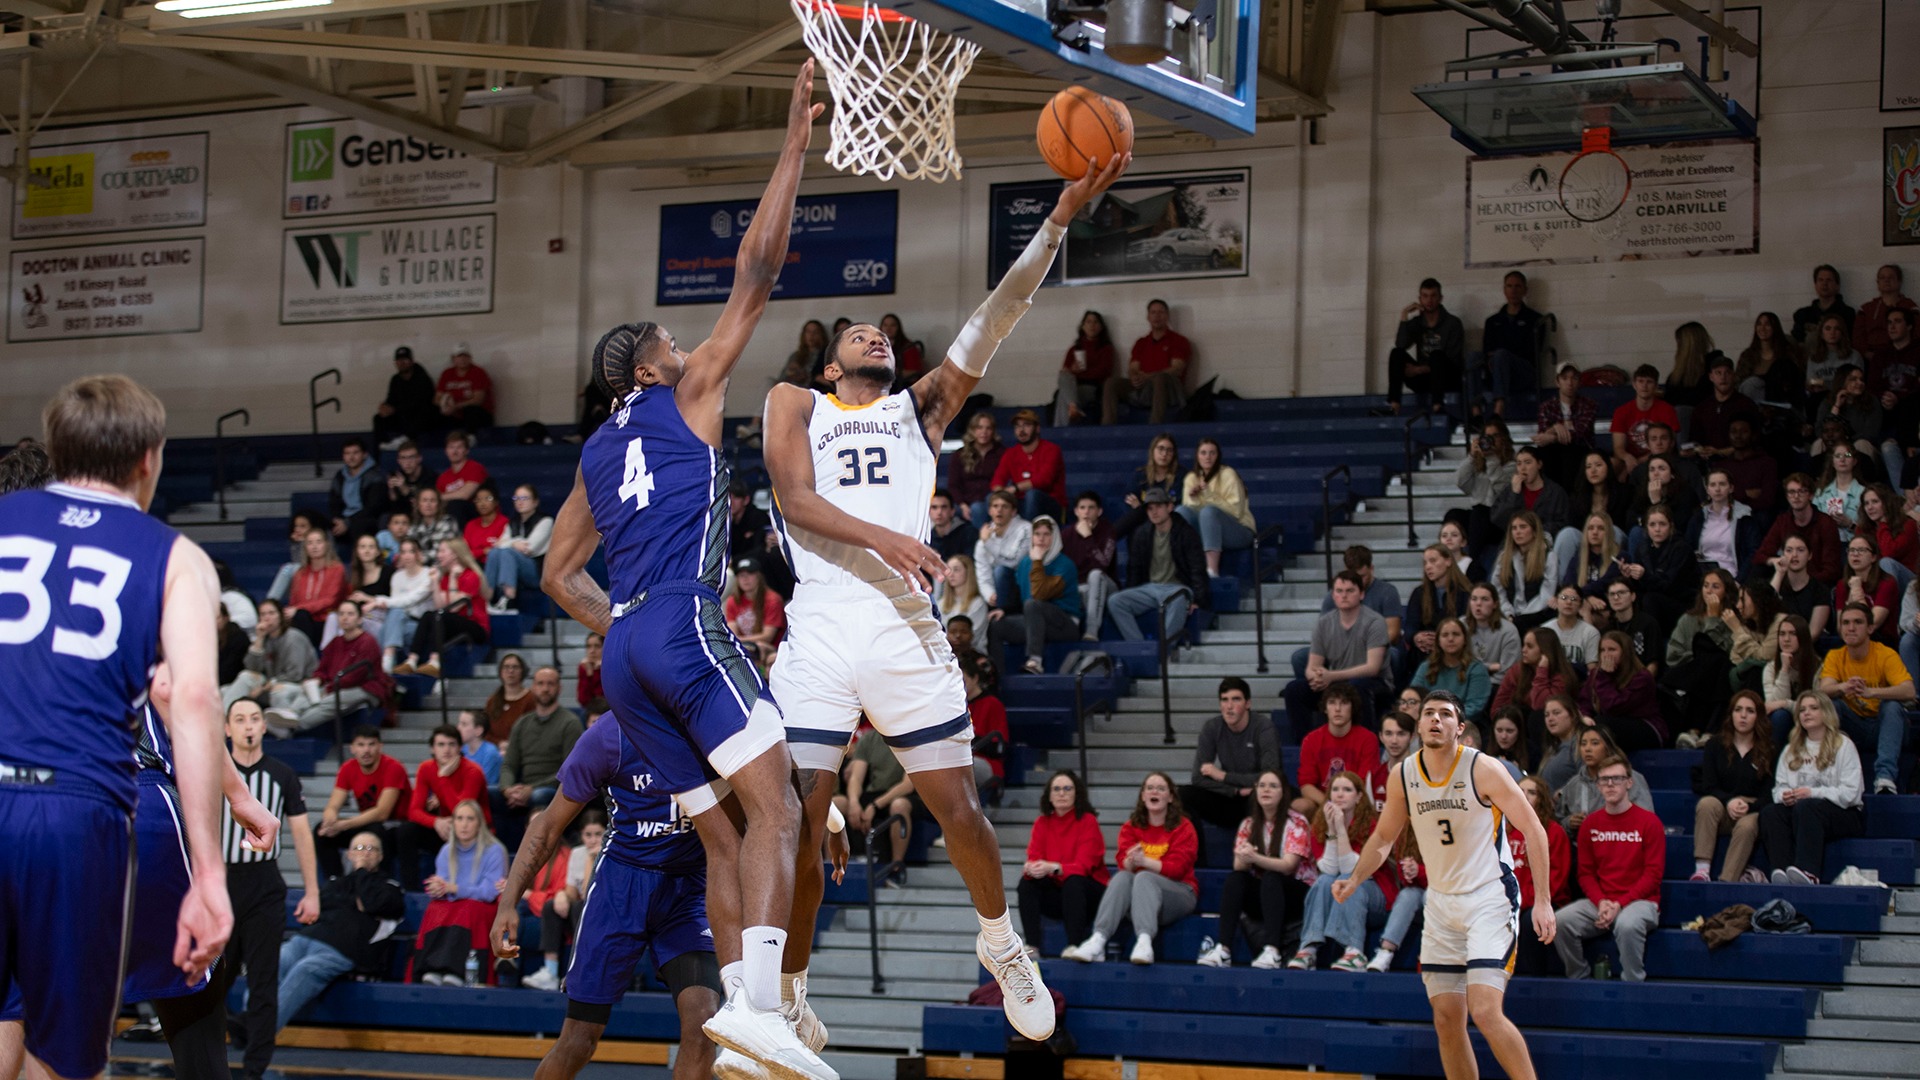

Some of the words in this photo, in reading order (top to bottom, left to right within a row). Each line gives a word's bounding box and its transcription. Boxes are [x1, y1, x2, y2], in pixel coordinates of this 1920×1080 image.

[101, 166, 200, 190] COURTYARD
[359, 174, 381, 187] Live
[384, 173, 405, 185] Life
[425, 169, 468, 182] Mission
[1630, 169, 1674, 179] Certificate
[1676, 167, 1686, 176] of
[1688, 165, 1735, 176] Excellence
[1637, 192, 1649, 202] 10
[1652, 191, 1662, 202] S.
[1666, 190, 1692, 201] Main
[1695, 188, 1727, 199] Street
[1009, 198, 1044, 215] Ford
[1477, 200, 1569, 216] HEARTHSTONE
[1636, 201, 1727, 217] CEDARVILLE
[738, 204, 837, 227] CPION
[1495, 222, 1529, 233] HOTEL
[1533, 221, 1541, 231] &
[1546, 220, 1583, 231] SUITES
[1641, 221, 1721, 235] 937-766-3000
[381, 225, 486, 255] WALLACE
[1627, 234, 1735, 247] hearthstoneinn.com
[22, 257, 80, 276] DOCTON
[82, 252, 137, 271] ANIMAL
[140, 248, 192, 267] CLINIC
[379, 265, 390, 287] &
[397, 256, 485, 285] TURNER
[118, 275, 148, 288] Road
[618, 436, 655, 511] 4
[837, 446, 890, 487] 32
[1416, 798, 1468, 815] CEDARVILLE
[636, 817, 696, 838] WESLE
[1438, 819, 1455, 845] 3
[1590, 828, 1643, 842] Connect.
